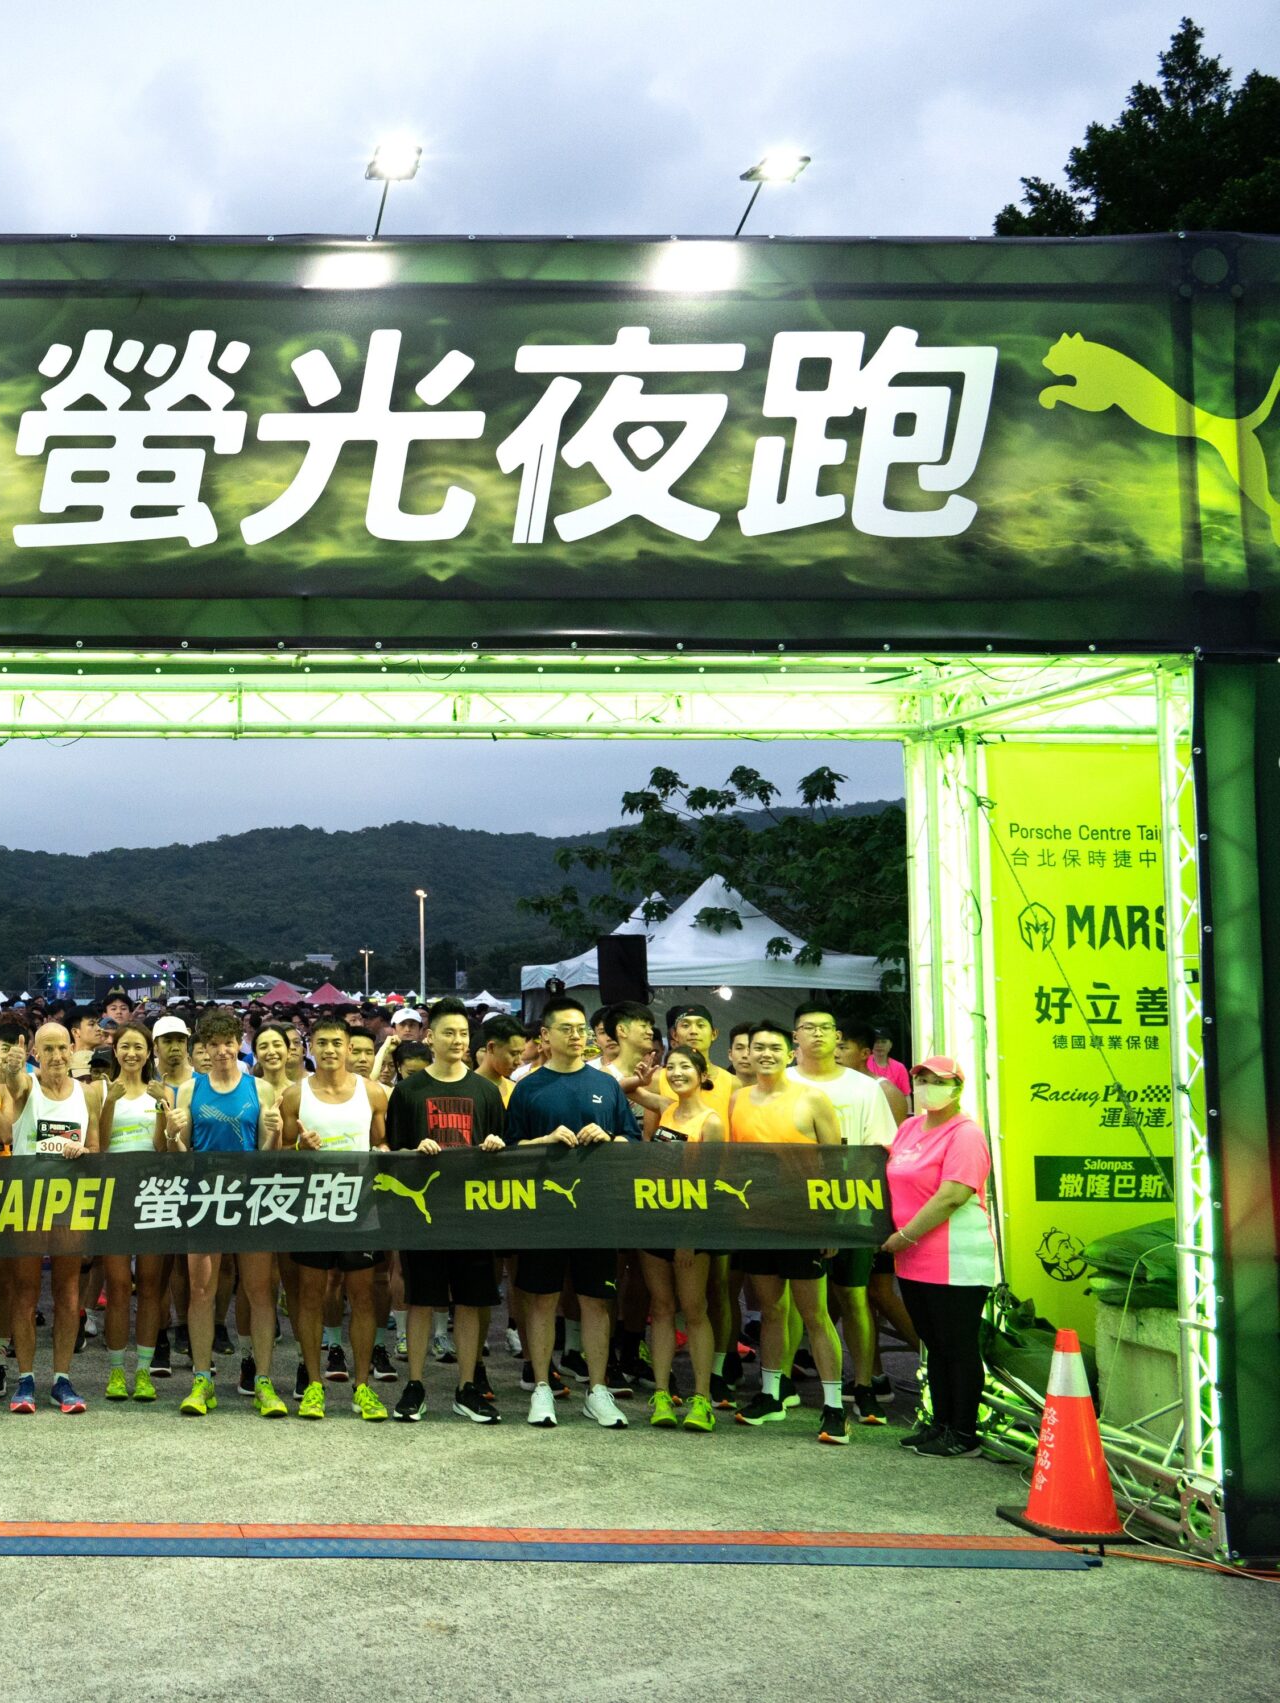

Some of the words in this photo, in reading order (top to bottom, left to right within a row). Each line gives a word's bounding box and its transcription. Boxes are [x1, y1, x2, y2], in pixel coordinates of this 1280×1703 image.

[12, 326, 999, 548] 螢光夜跑
[1009, 823, 1071, 840] Porsche
[1078, 825, 1131, 841] Centre
[1011, 847, 1181, 868] 台北保時捷中
[1034, 981, 1168, 1027] 好立善
[1052, 1035, 1160, 1050] 德國專業保健
[1099, 1107, 1173, 1128] 運動達
[40, 1141, 67, 1153] 300
[465, 1180, 536, 1211] RUN
[633, 1178, 708, 1210] RUN
[807, 1179, 884, 1210] RUN
[1058, 1173, 1165, 1199] 撒隆巴斯
[134, 1172, 363, 1230] 螢光夜跑
